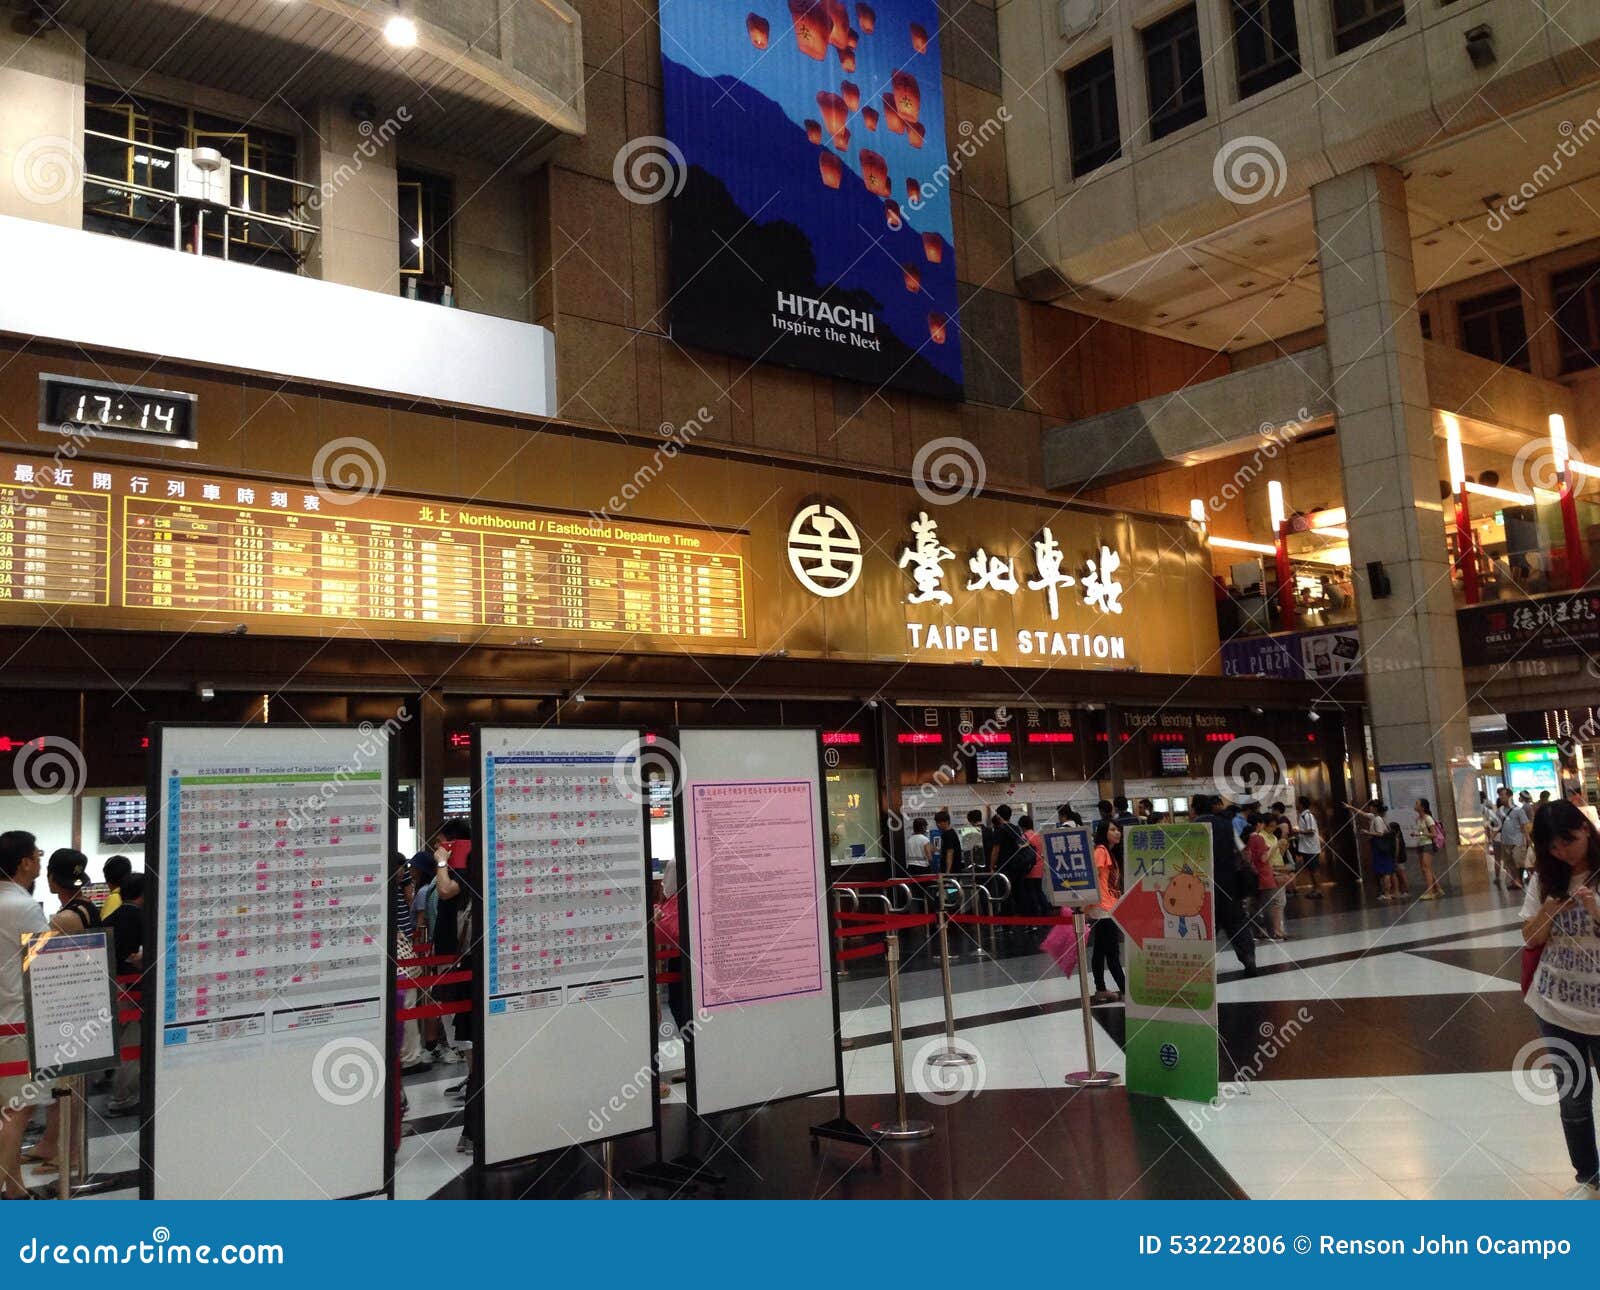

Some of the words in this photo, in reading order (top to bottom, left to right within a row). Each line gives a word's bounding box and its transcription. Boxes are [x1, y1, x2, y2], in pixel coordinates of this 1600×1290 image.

[777, 290, 875, 333] HITACHI
[772, 313, 821, 338] Inspire
[825, 328, 847, 344] the
[850, 332, 880, 352] Next
[76, 395, 174, 432] 17:14
[14, 464, 320, 511] 最近開行列車時刻表
[418, 506, 451, 524] 北上
[459, 512, 536, 531] Northbound
[539, 521, 545, 532] /
[547, 521, 612, 539] Eastbound
[614, 529, 671, 545] Departure
[673, 534, 701, 547] Time
[899, 511, 1124, 621] 臺北車站
[906, 623, 999, 652] TAIPEI
[1018, 630, 1125, 659] STATION
[1055, 854, 1087, 871] 入口
[1134, 857, 1165, 876] 入口
